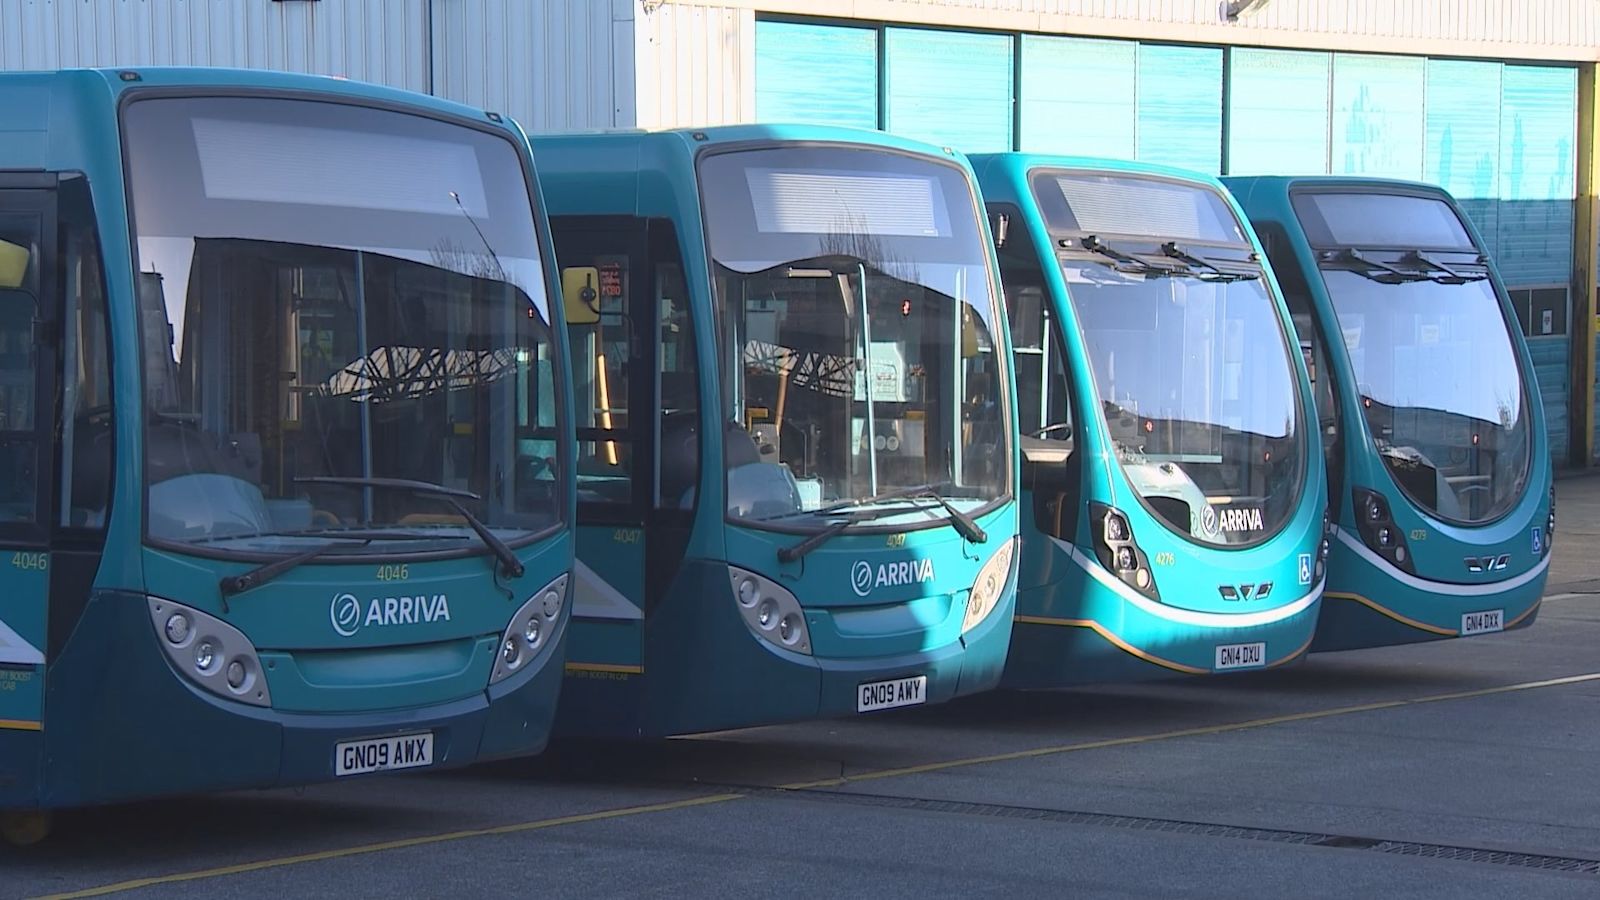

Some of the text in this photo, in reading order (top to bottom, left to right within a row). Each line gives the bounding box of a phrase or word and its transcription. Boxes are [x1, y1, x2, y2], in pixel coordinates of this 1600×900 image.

[1219, 508, 1264, 532] ARRIVA
[613, 528, 641, 544] 4047
[11, 551, 48, 570] 4046
[376, 564, 409, 581] 4046
[875, 558, 935, 588] ARRIVA
[364, 594, 451, 627] ARRIVA
[1484, 613, 1499, 629] DXX
[1221, 645, 1260, 666] GN14 DXU
[862, 679, 921, 706] GN09 AWY
[343, 737, 427, 770] GN09 AWX
